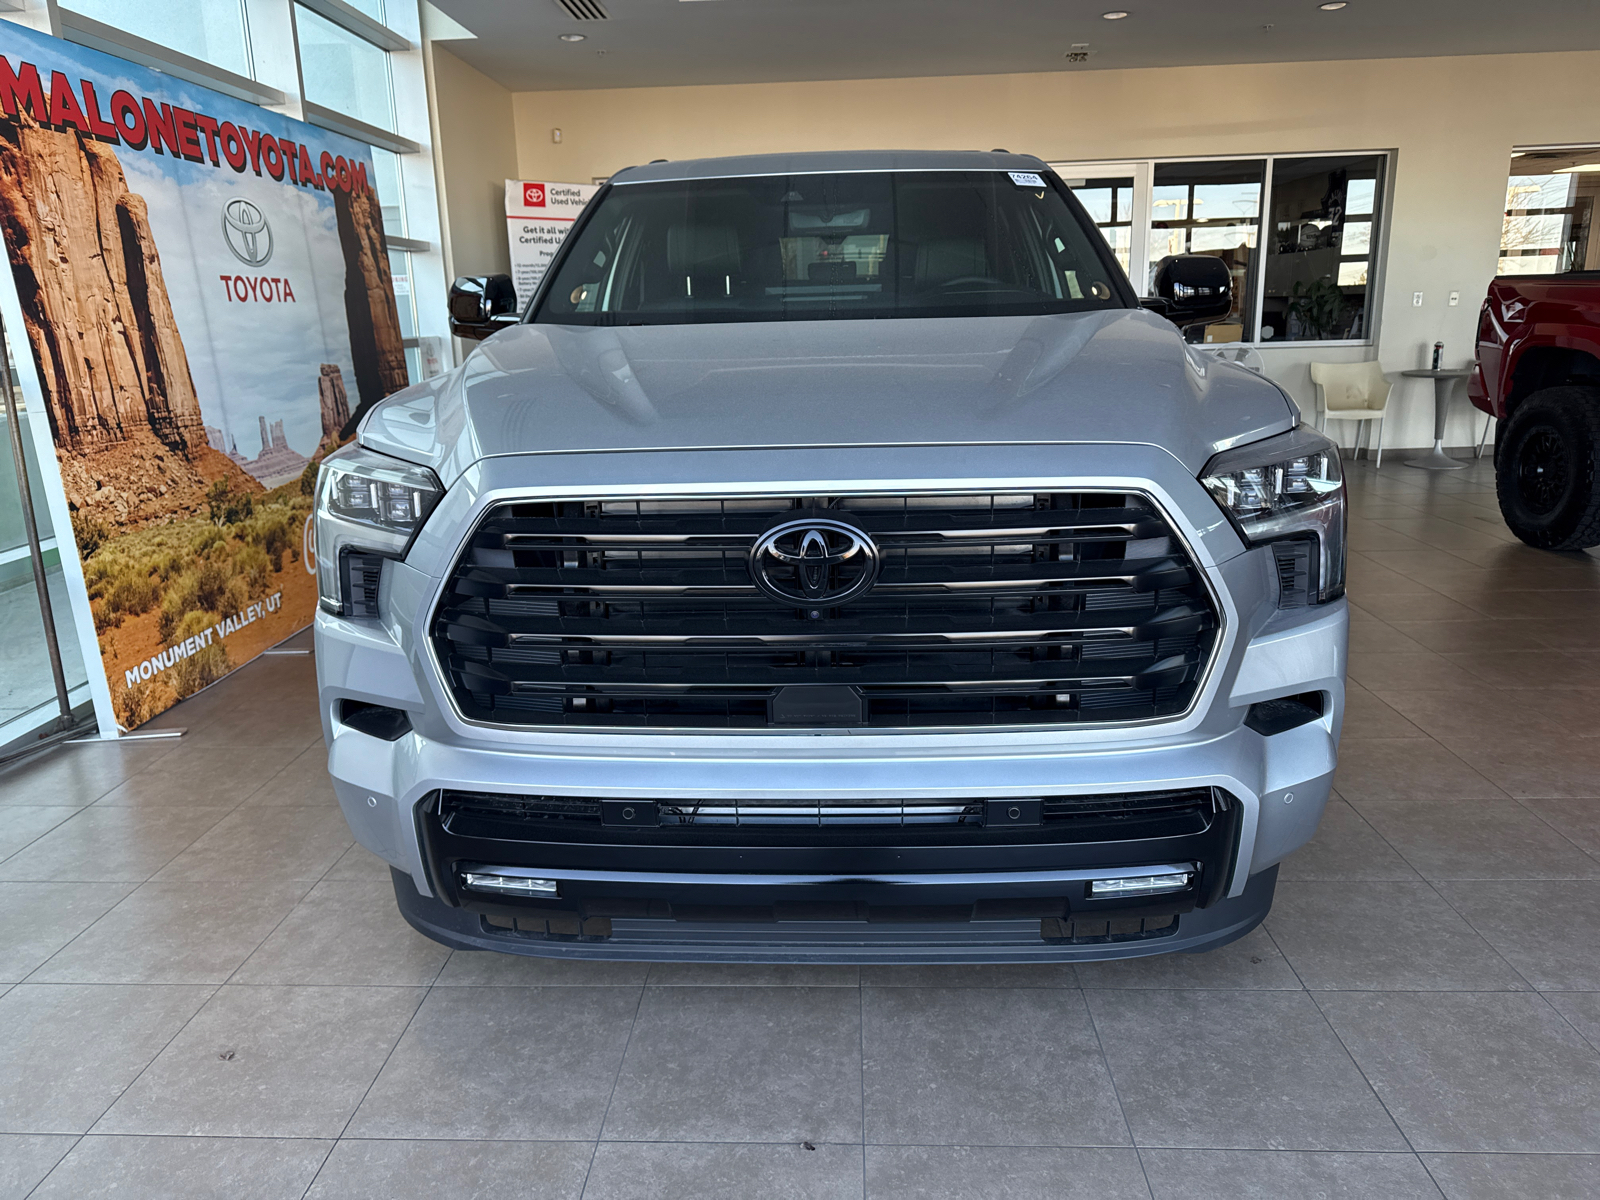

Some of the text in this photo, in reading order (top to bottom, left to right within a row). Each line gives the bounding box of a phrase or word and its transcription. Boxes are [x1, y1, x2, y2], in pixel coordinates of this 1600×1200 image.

[0, 54, 371, 197] MALONETOYOTA.COM
[550, 188, 581, 197] Certified
[551, 197, 590, 206] Used Vehic
[523, 226, 538, 235] Get
[539, 226, 545, 234] it
[546, 226, 556, 235] all
[519, 236, 553, 245] Certified
[220, 275, 296, 303] TOYOTA
[125, 592, 282, 689] MONUMENT VALLEY, UT
